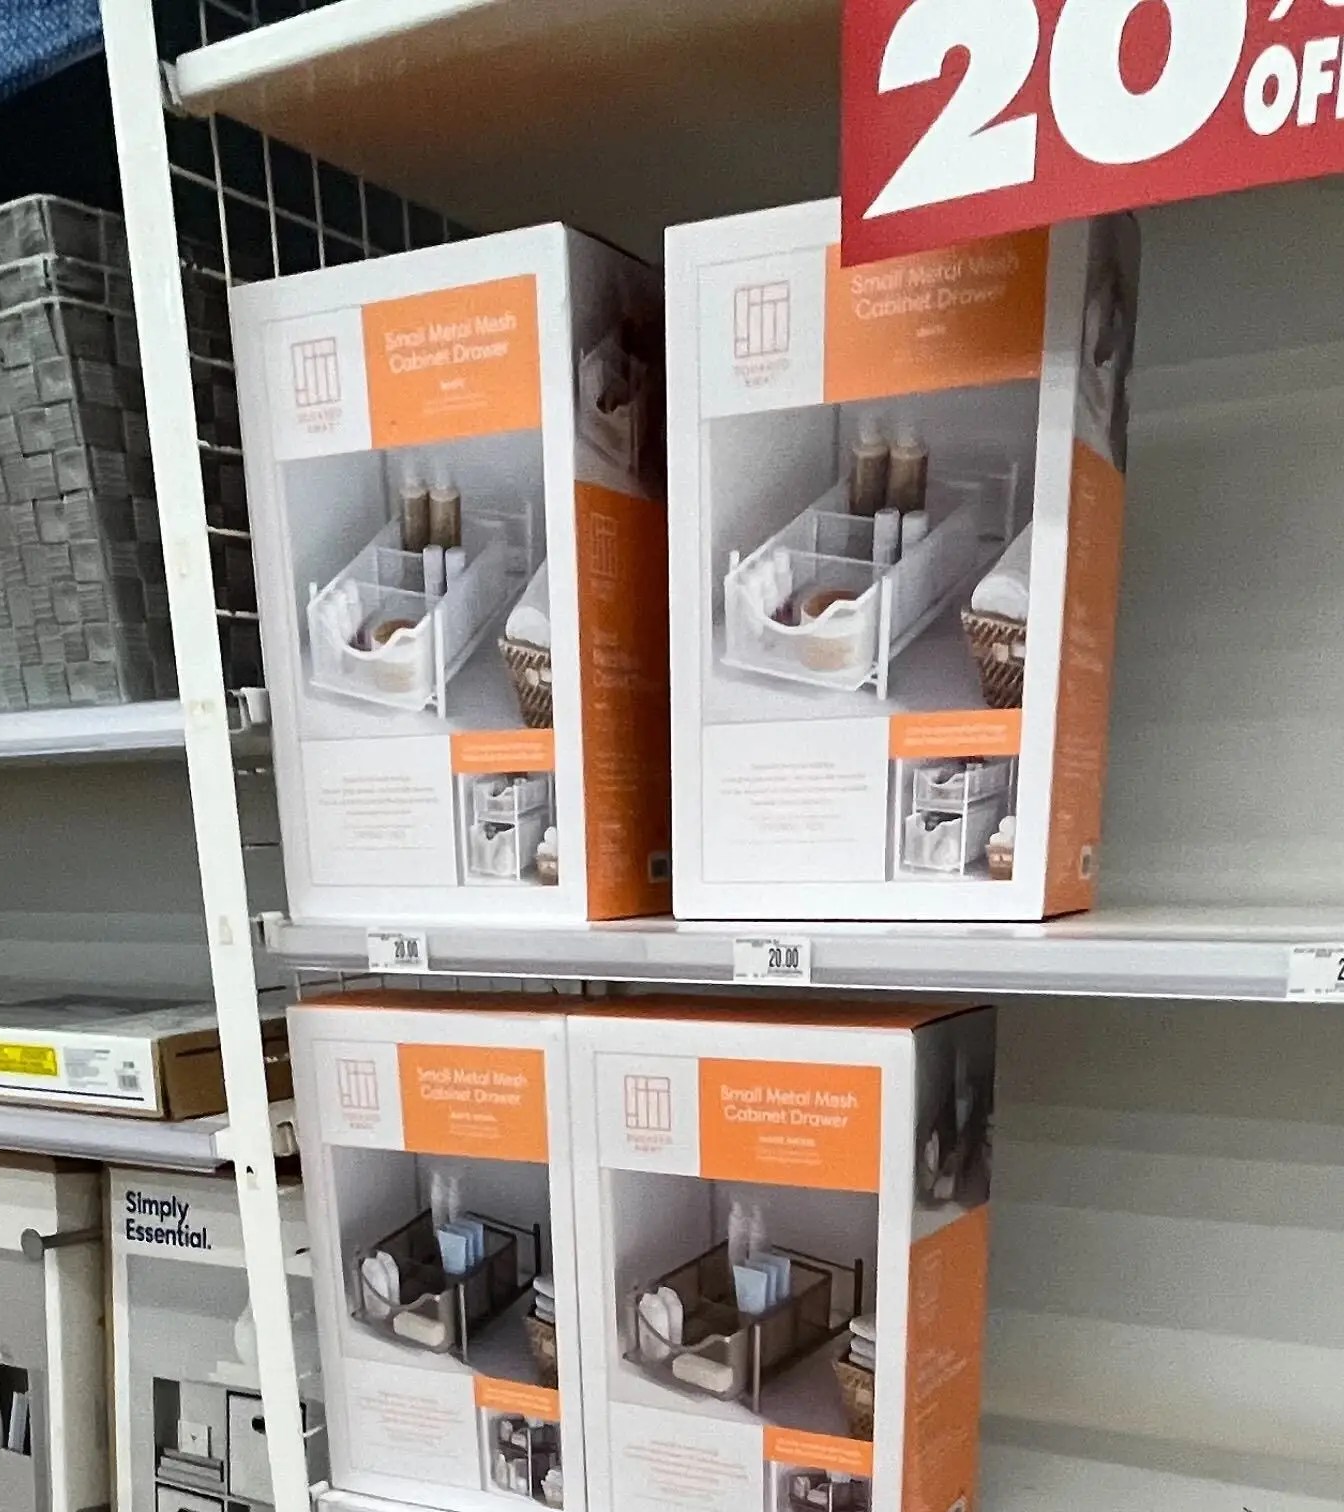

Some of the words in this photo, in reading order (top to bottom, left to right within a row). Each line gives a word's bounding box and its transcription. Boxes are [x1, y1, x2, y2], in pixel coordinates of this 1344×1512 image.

[720, 1084, 762, 1103] Small
[766, 1087, 812, 1106] Metal
[814, 1090, 858, 1108] Mesh
[724, 1104, 788, 1124] Cabinet
[790, 1108, 848, 1128] Drawer
[125, 1190, 190, 1225] Simply
[125, 1218, 212, 1250] Essential.
